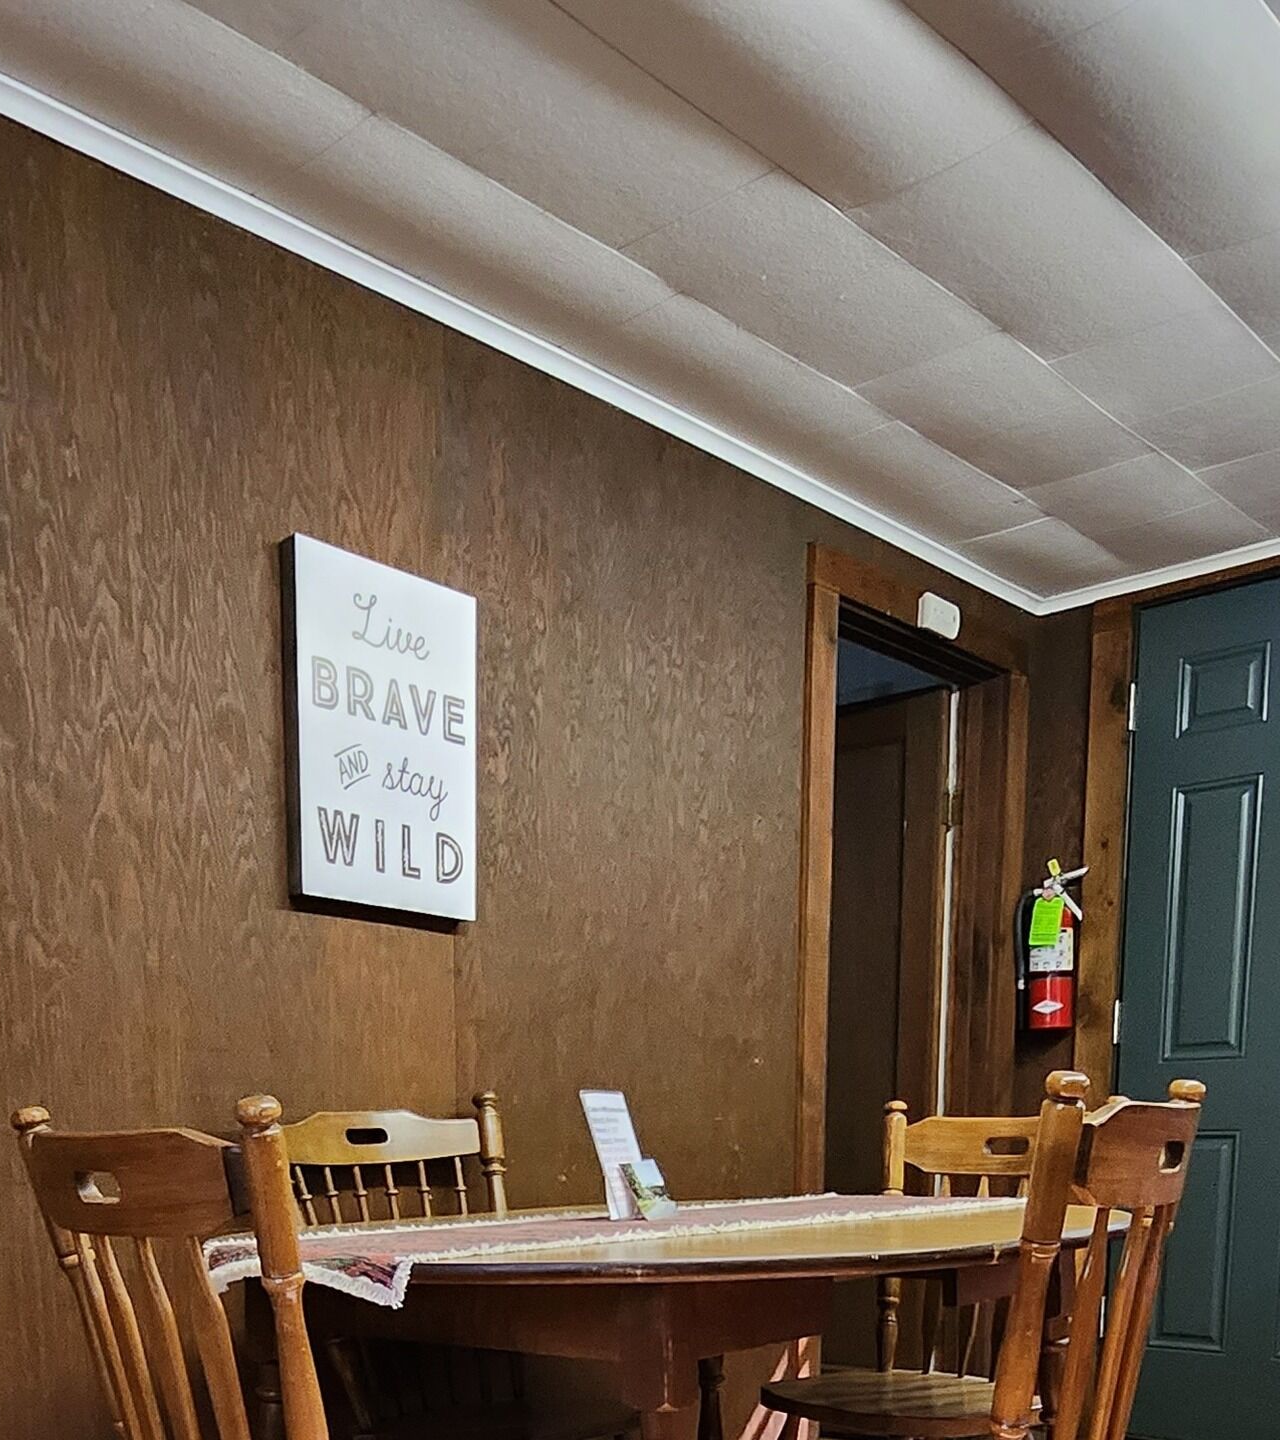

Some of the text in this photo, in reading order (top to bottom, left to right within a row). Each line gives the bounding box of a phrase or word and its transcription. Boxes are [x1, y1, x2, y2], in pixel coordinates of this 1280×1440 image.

[352, 592, 430, 661] Live
[311, 655, 466, 746] BRAVE
[336, 748, 448, 822] AND stay
[317, 805, 464, 884] WILD
